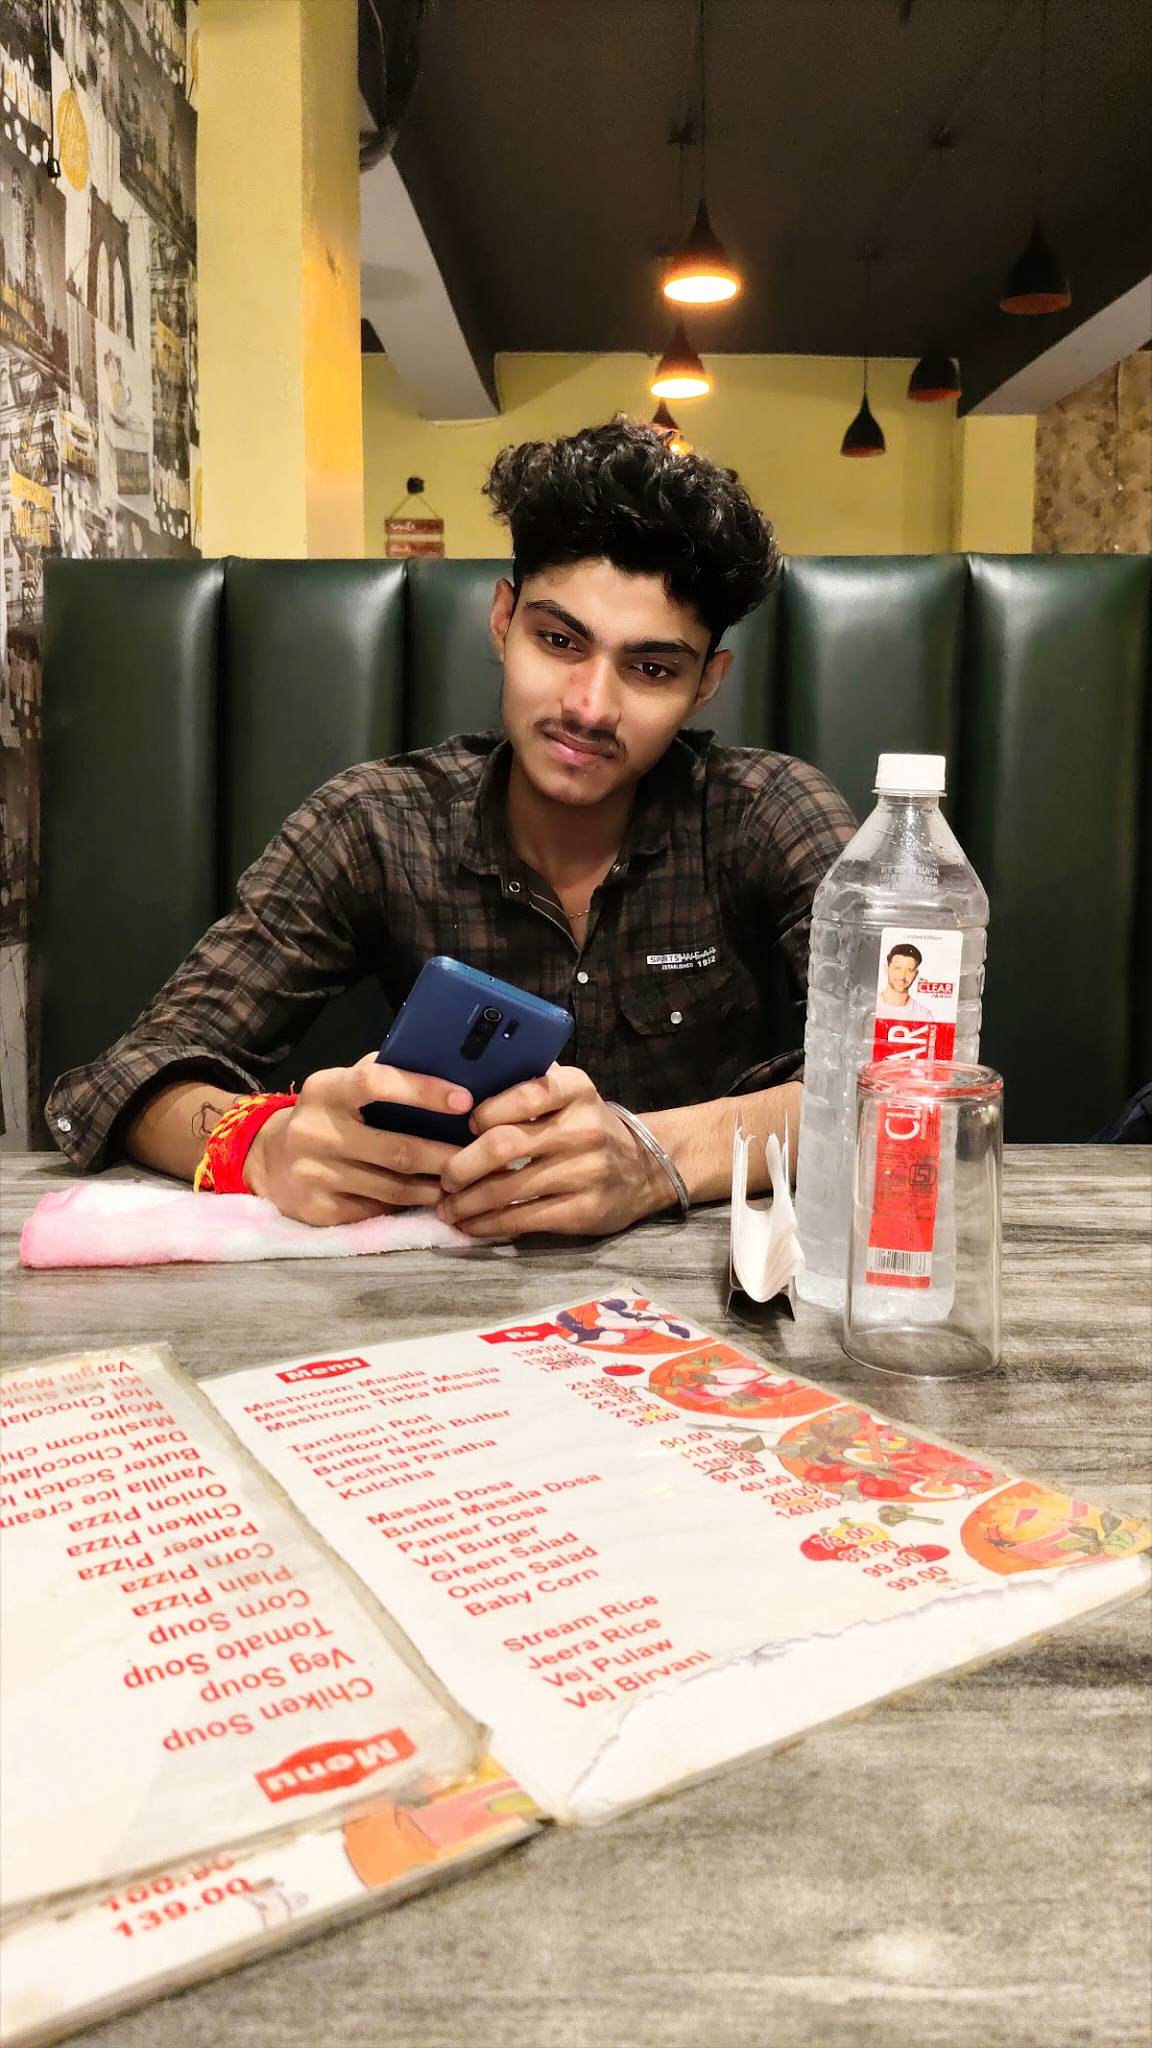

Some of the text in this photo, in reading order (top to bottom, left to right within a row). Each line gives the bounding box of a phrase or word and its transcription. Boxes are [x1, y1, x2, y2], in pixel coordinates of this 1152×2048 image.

[661, 962, 694, 971] ESTABLISHED
[918, 982, 953, 994] CLEAR
[243, 1368, 427, 1414] Mashroom Masala
[284, 1359, 362, 1380] Menu
[90, 1400, 164, 1423] Mojito
[110, 1387, 153, 1401] Hot
[254, 1365, 500, 1423] Mashroom Butter Masala
[265, 1376, 501, 1433] Mashroon Tikka Masala
[45, 1414, 176, 1450] Mashroom
[129, 1430, 188, 1452] Dark
[289, 1412, 433, 1454] Tandoori Roti
[299, 1408, 512, 1465] Tandoori Roti Butter
[122, 1447, 200, 1476] Butter
[126, 1465, 216, 1496] Vanilla
[312, 1437, 445, 1477] Butter Naan
[324, 1438, 497, 1489] Lachha Paratha
[24, 1469, 115, 1502] Scotch
[81, 1488, 121, 1506] ice
[338, 1469, 435, 1500] Kulchha
[366, 1479, 514, 1526] Masala Dosa
[381, 1473, 602, 1539] Butter Masala Dosa
[739, 1474, 792, 1493] 40.00
[763, 1484, 819, 1505] 20.00
[66, 1503, 242, 1559] Chiken Pizza
[67, 1483, 227, 1534] Onion Pizza
[397, 1504, 548, 1553] Paneer Dosa
[774, 1497, 842, 1520] 140.00
[77, 1522, 259, 1582] Paneer Pizza
[120, 1542, 274, 1595] Corn Pizza
[412, 1524, 539, 1568] Vej Burger
[430, 1531, 579, 1583] Green Salad
[863, 1551, 926, 1578] 99.00
[131, 1565, 294, 1618] Plain Pizza
[447, 1545, 599, 1599] Onion Salad
[464, 1568, 600, 1617] Baby Corn
[886, 1566, 948, 1591] 99.00
[147, 1589, 310, 1646] Corn Soup
[503, 1593, 659, 1652] Stream Rice
[122, 1616, 333, 1690] Tomato Soup
[528, 1617, 662, 1670] Jeera Rice
[541, 1638, 674, 1688] Vej Pulaw
[199, 1646, 355, 1704] Veg Soup
[563, 1684, 617, 1710] Vej
[162, 1676, 374, 1753] Chiken Soup
[265, 1737, 400, 1793] Menu
[114, 1877, 251, 1938] 139.00
